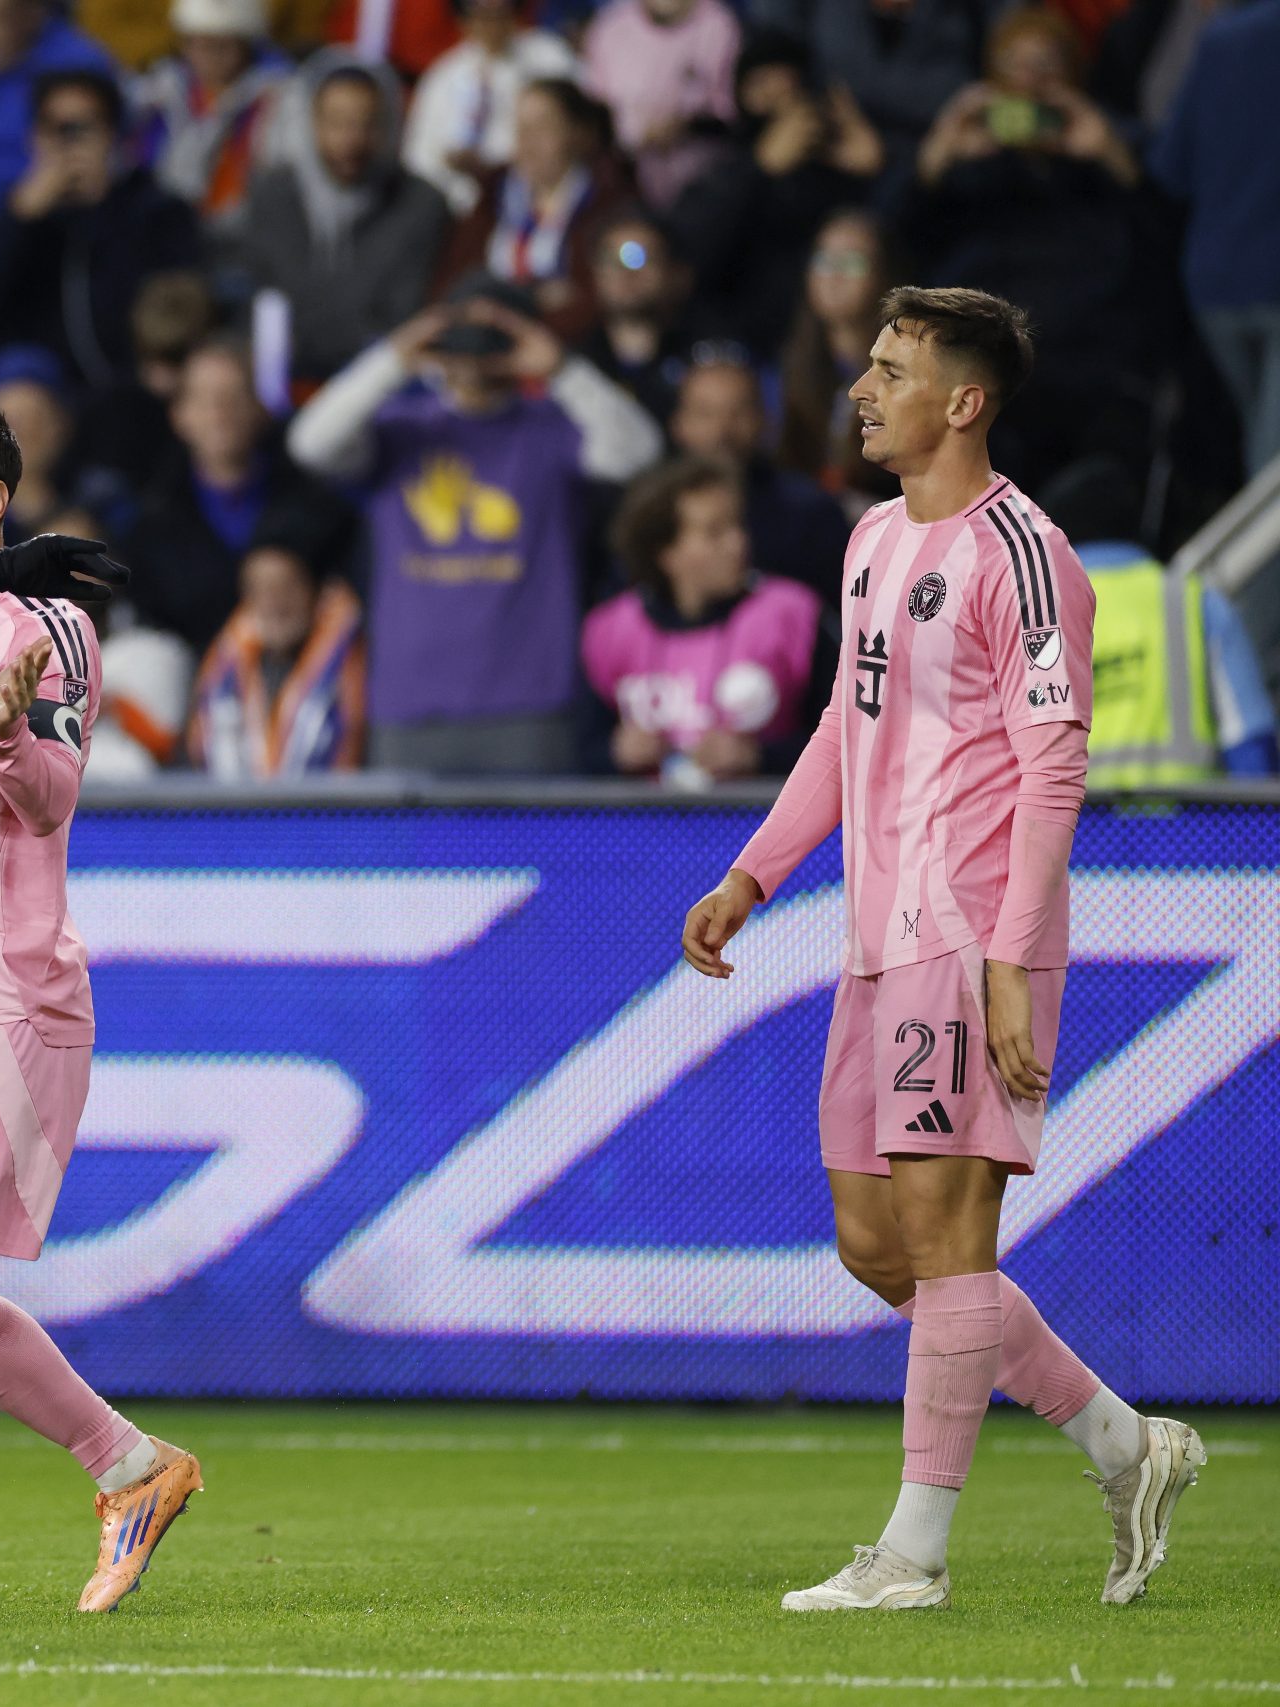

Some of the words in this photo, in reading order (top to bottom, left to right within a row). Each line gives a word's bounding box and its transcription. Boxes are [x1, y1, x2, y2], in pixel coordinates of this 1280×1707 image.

[1026, 633, 1046, 645] MLS
[67, 683, 84, 695] MLS
[1046, 682, 1070, 704] tv
[893, 1018, 968, 1095] 21
